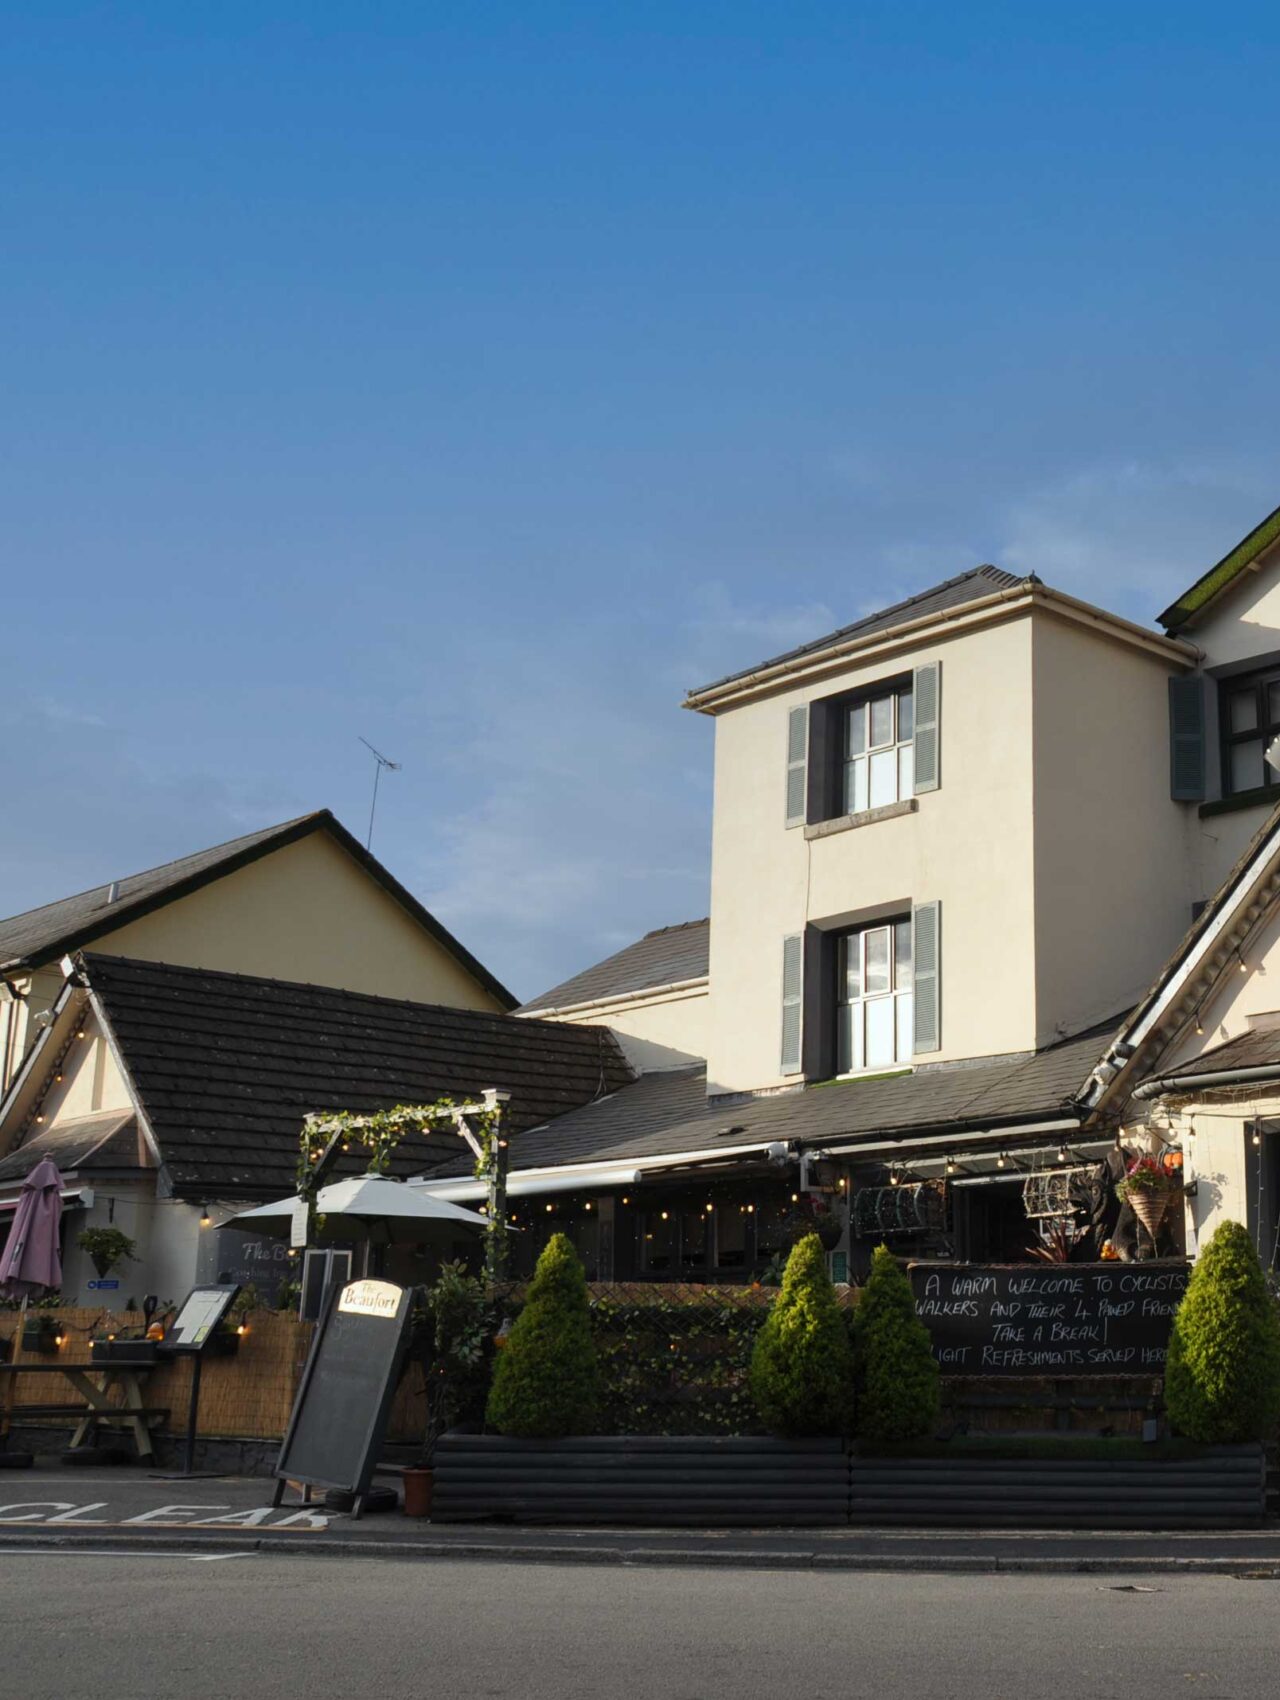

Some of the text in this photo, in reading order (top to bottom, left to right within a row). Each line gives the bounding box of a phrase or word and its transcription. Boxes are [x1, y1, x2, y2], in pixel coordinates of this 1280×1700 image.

[925, 1274, 940, 1296] A
[952, 1276, 997, 1296] WARM
[1008, 1275, 1084, 1295] WELCOME
[1092, 1275, 1113, 1293] TO
[344, 1288, 396, 1312] Beaufort
[914, 1298, 979, 1317] WALKERS
[990, 1302, 1021, 1317] AND
[1025, 1301, 1065, 1319] THEIR
[991, 1324, 1025, 1342] TAKE
[1033, 1325, 1042, 1341] A
[982, 1345, 1085, 1367] REFRESHMENTS
[1087, 1348, 1132, 1364] SERVED
[0, 1502, 336, 1528] CLEAR
